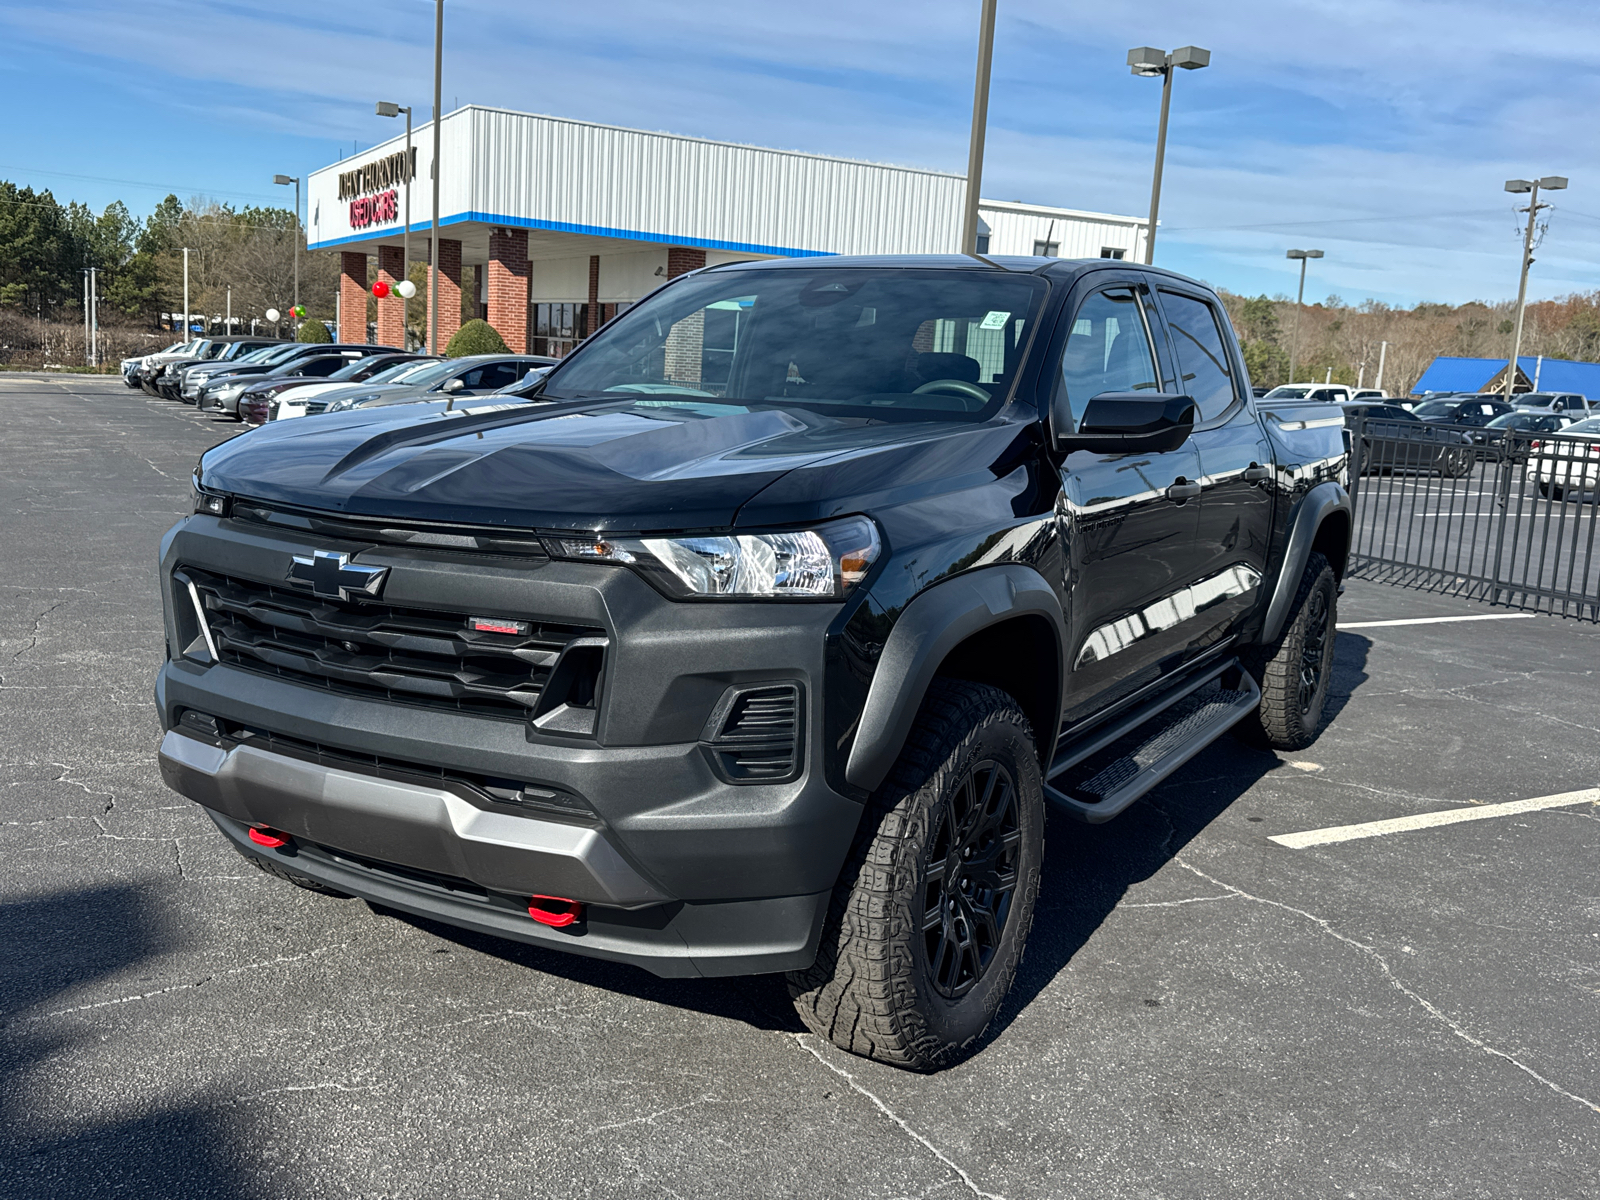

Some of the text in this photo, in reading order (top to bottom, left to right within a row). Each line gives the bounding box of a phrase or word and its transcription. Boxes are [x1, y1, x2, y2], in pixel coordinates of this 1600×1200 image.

[338, 168, 360, 200] JOHN
[349, 189, 396, 228] USED CARS
